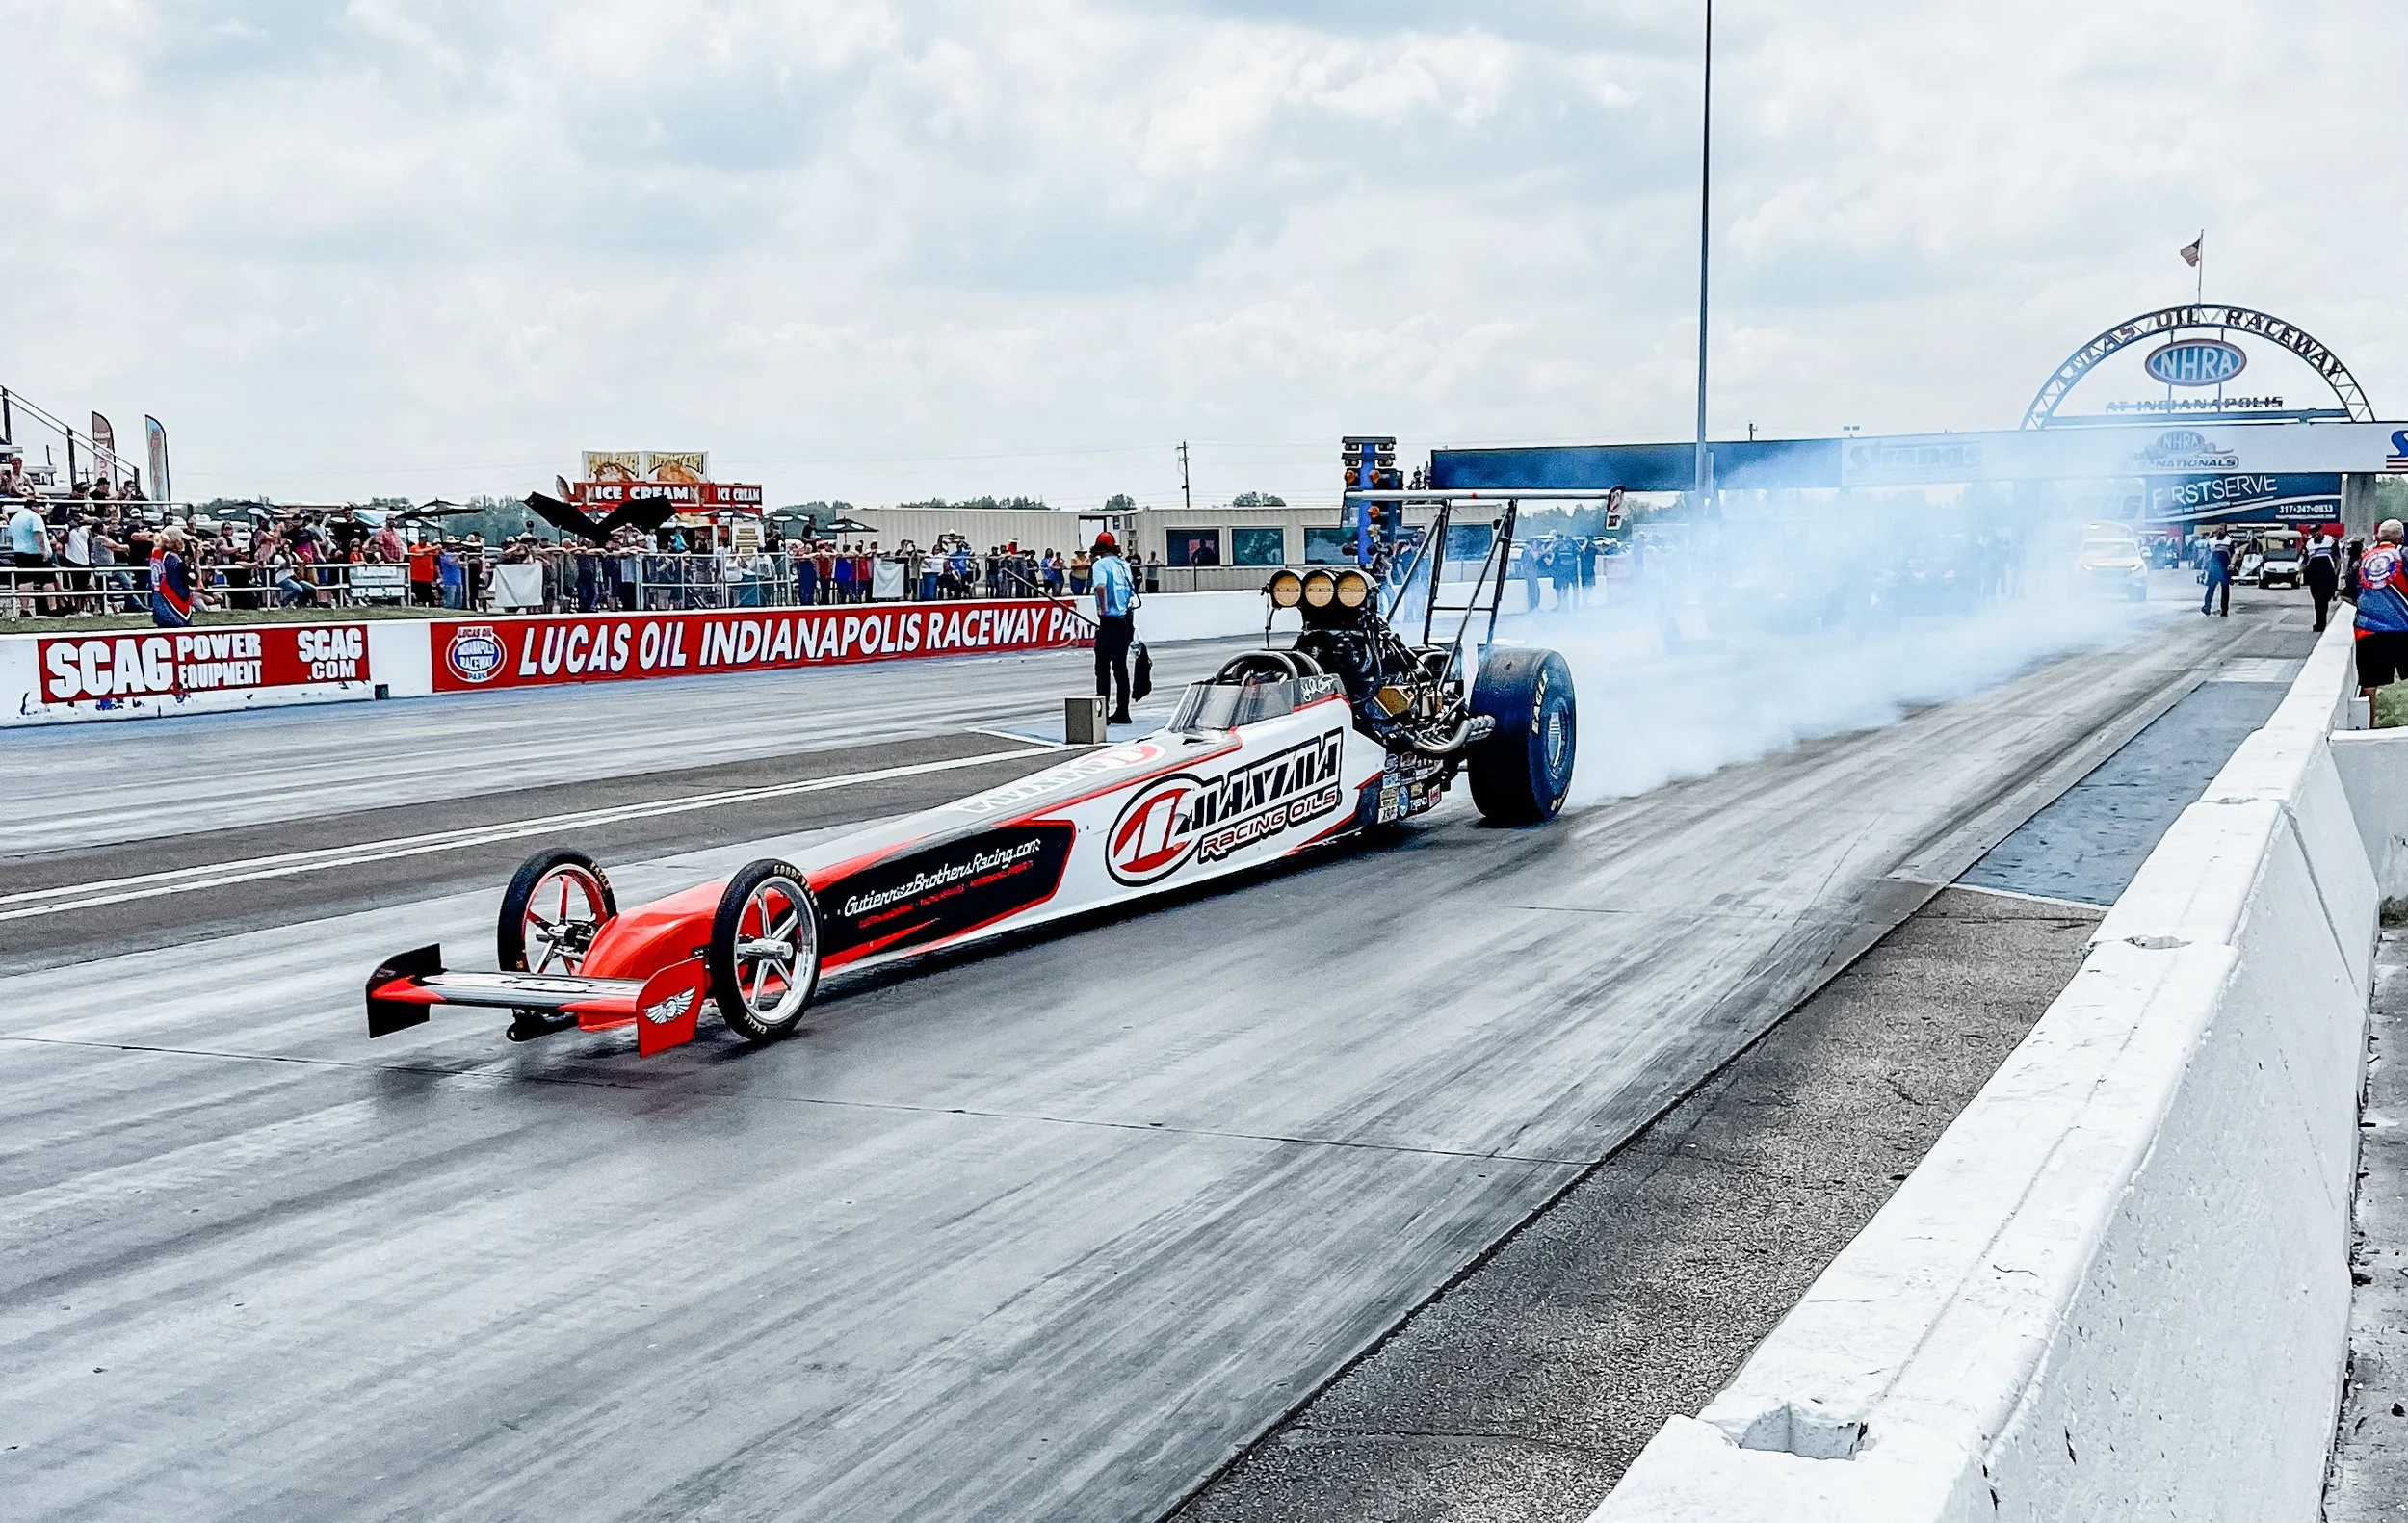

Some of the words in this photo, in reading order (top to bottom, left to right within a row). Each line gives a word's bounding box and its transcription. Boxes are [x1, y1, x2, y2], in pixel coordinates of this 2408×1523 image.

[2156, 308, 2200, 328] OIL
[2225, 308, 2344, 377] RACEWAY
[2159, 346, 2235, 381] NHRA
[2135, 396, 2284, 411] INDIANAPOLIS
[2155, 458, 2236, 468] NATIONALS
[595, 486, 622, 500] ICE
[629, 486, 690, 500] CREAM
[717, 487, 731, 501] ICE
[2152, 475, 2278, 510] FRSTSERVE
[176, 631, 263, 662] POWER
[297, 627, 364, 663] SCAG
[518, 622, 632, 676] LUCAS
[639, 621, 688, 670] OIL
[698, 613, 923, 667] INDIANAPOLIS
[926, 607, 1047, 650] RACEWAY
[46, 636, 174, 699] SCAG
[177, 660, 263, 690] EQUIPMENT
[307, 660, 357, 681] .COM
[1291, 789, 1337, 820] OILS
